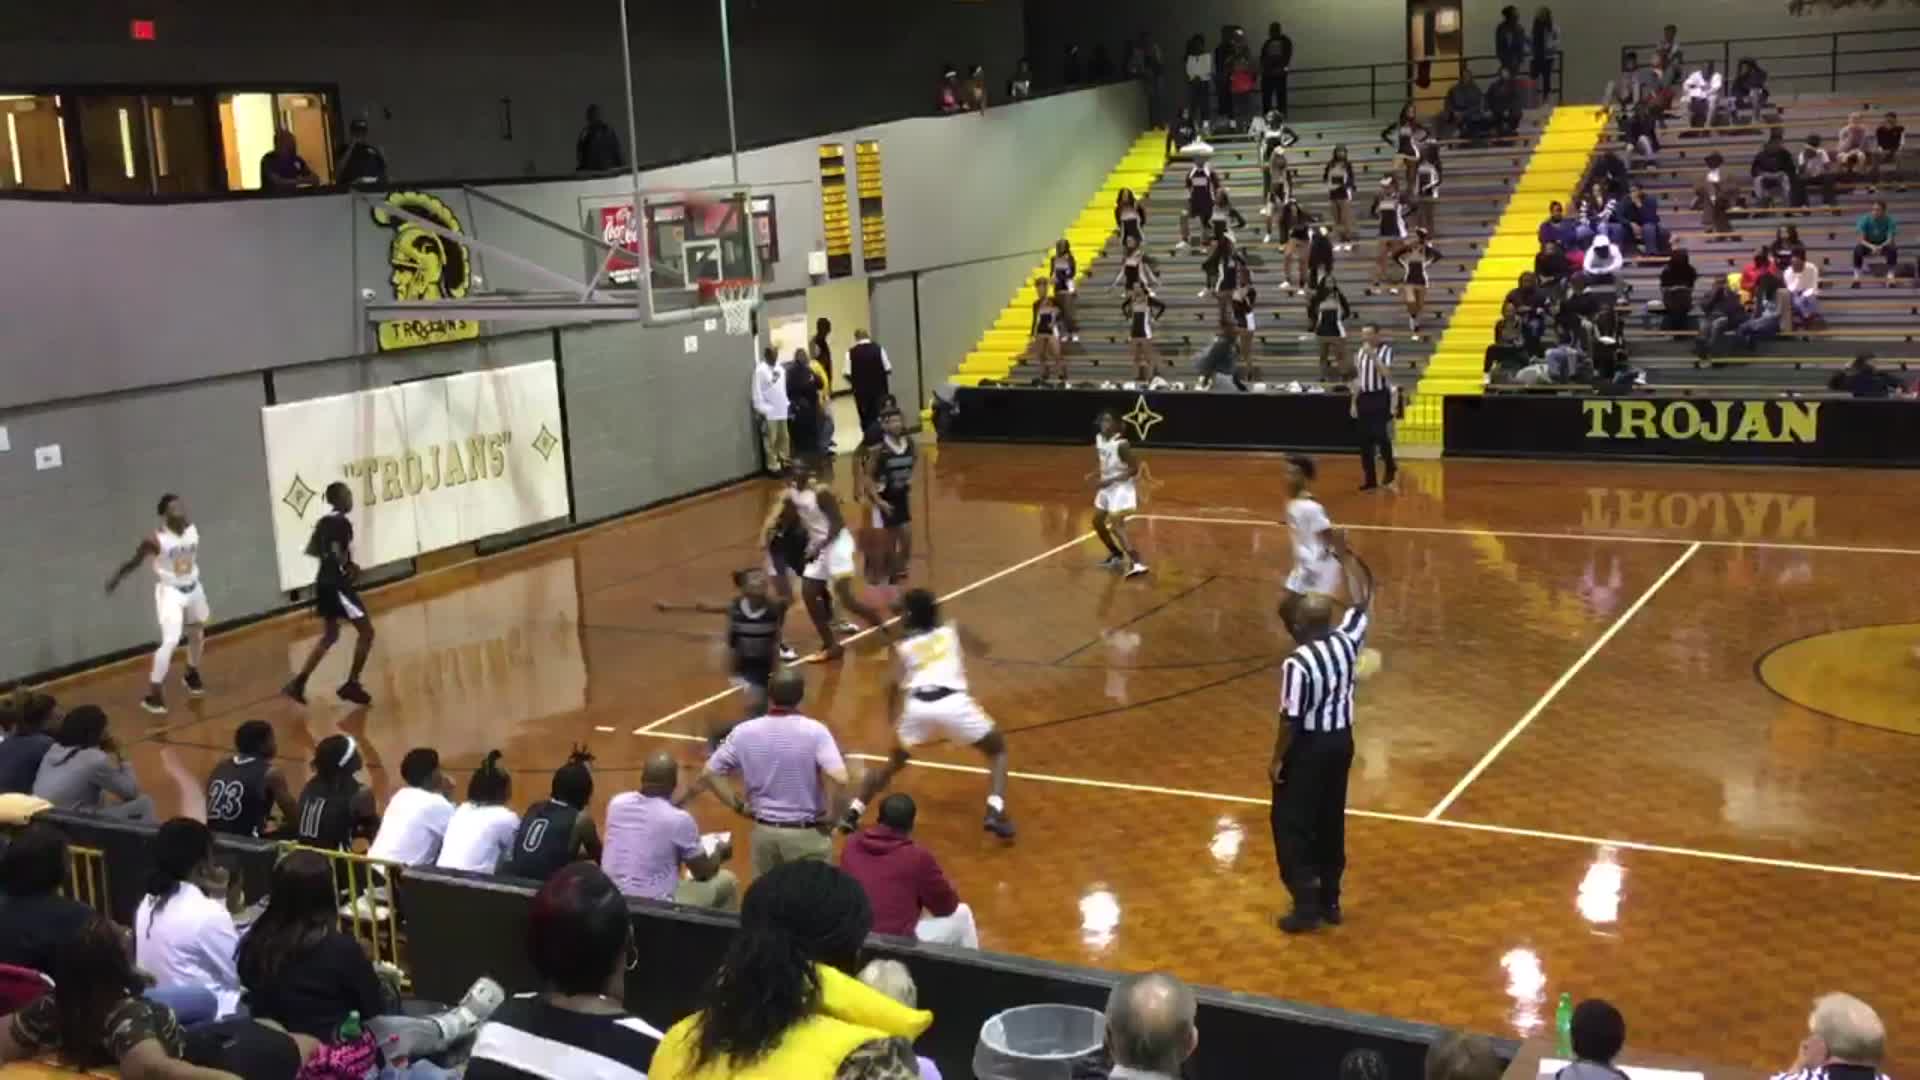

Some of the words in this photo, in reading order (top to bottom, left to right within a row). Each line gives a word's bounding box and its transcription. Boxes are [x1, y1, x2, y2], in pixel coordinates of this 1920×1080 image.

[1583, 400, 1821, 443] TROJAN
[207, 779, 245, 821] 23
[300, 797, 326, 839] 11
[522, 818, 549, 853] 0
